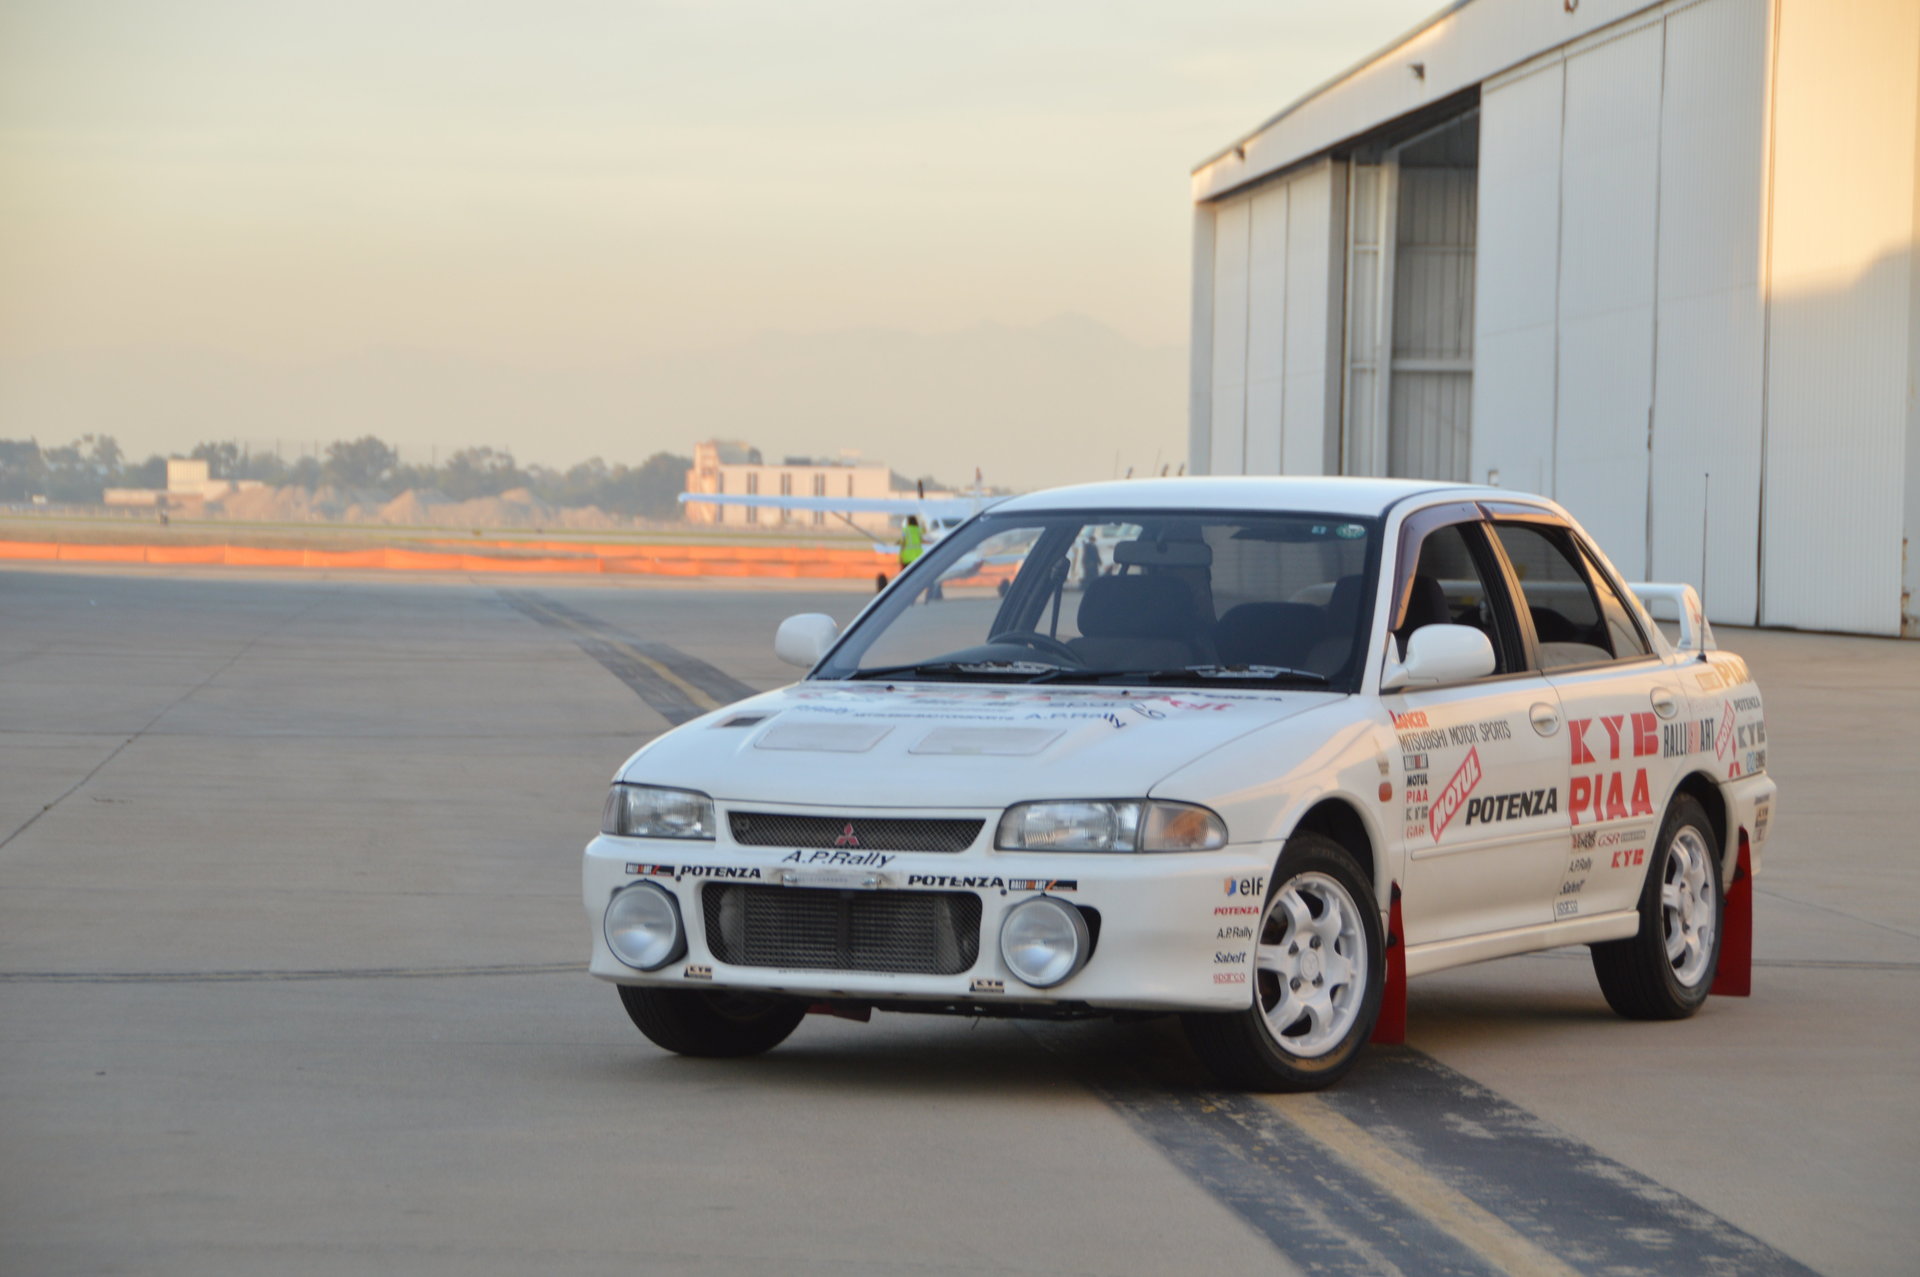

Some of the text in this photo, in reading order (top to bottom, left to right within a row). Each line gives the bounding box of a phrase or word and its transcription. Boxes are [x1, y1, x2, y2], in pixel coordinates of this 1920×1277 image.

[1388, 710, 1430, 730] LANCER
[1398, 720, 1512, 753] MITSUBISHI MOTOR SPORTS
[1568, 712, 1659, 766] KYB
[1406, 773, 1429, 787] MOTUL
[1406, 789, 1429, 804] PIAA
[1431, 750, 1481, 839] MOTUL
[1568, 768, 1654, 826] PIAA
[1406, 805, 1429, 821] KYB
[1465, 787, 1558, 826] POTENZA
[782, 850, 896, 868] A.P.Rally
[1611, 849, 1645, 868] KYB
[680, 865, 762, 879] POTENZA
[908, 875, 1004, 888] POTENZA
[1240, 877, 1263, 896] elf
[1214, 906, 1259, 916] POTENZA
[1216, 926, 1253, 940] A.P.Rally
[1213, 951, 1247, 963] Sabelt
